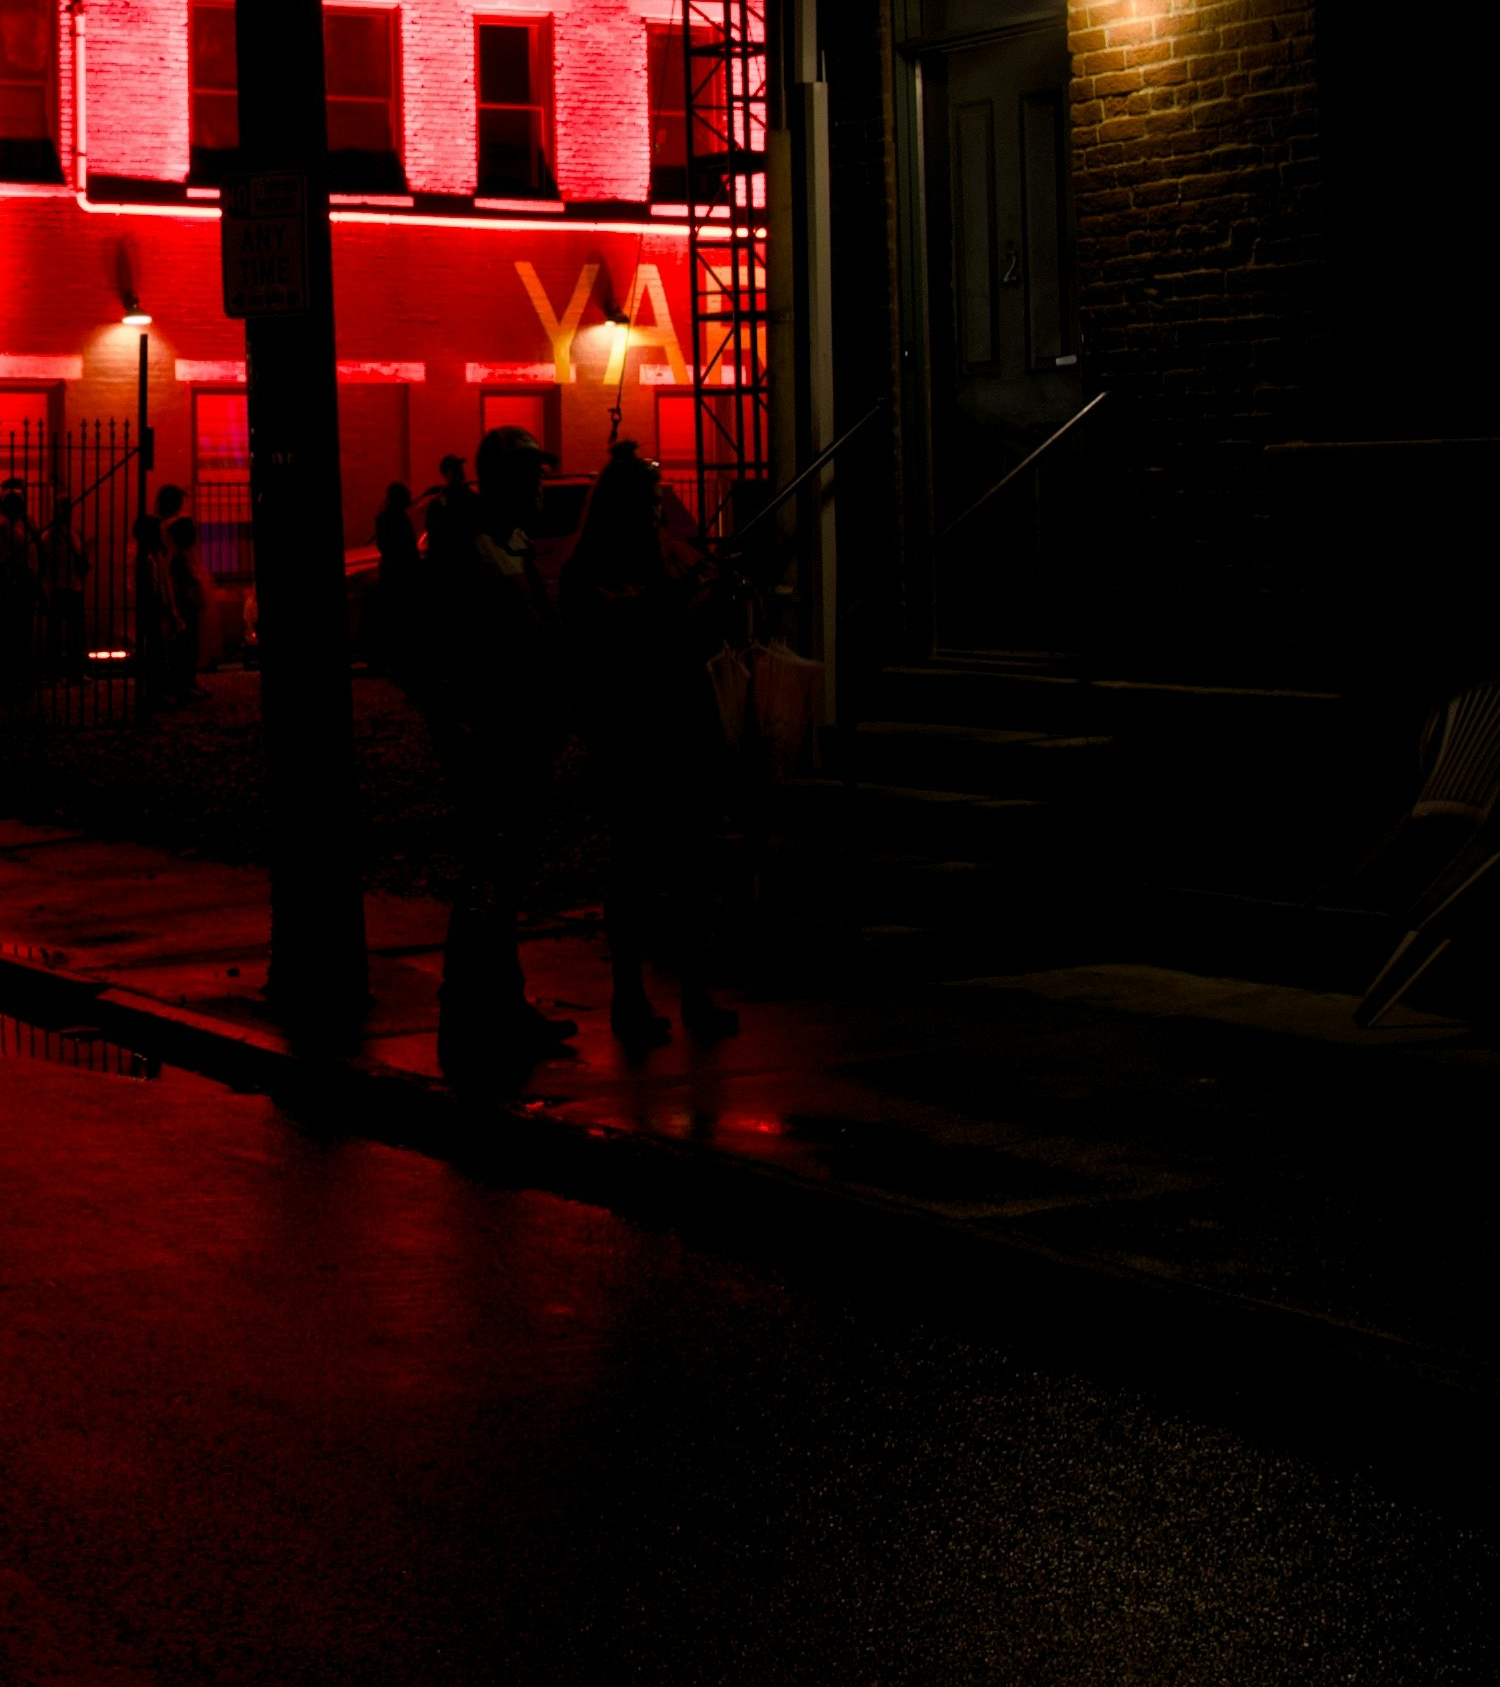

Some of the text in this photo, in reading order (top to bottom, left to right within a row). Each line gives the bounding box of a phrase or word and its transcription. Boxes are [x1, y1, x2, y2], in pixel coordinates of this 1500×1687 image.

[240, 225, 285, 251] ANY
[239, 257, 289, 286] TIME
[1003, 249, 1017, 283] 2
